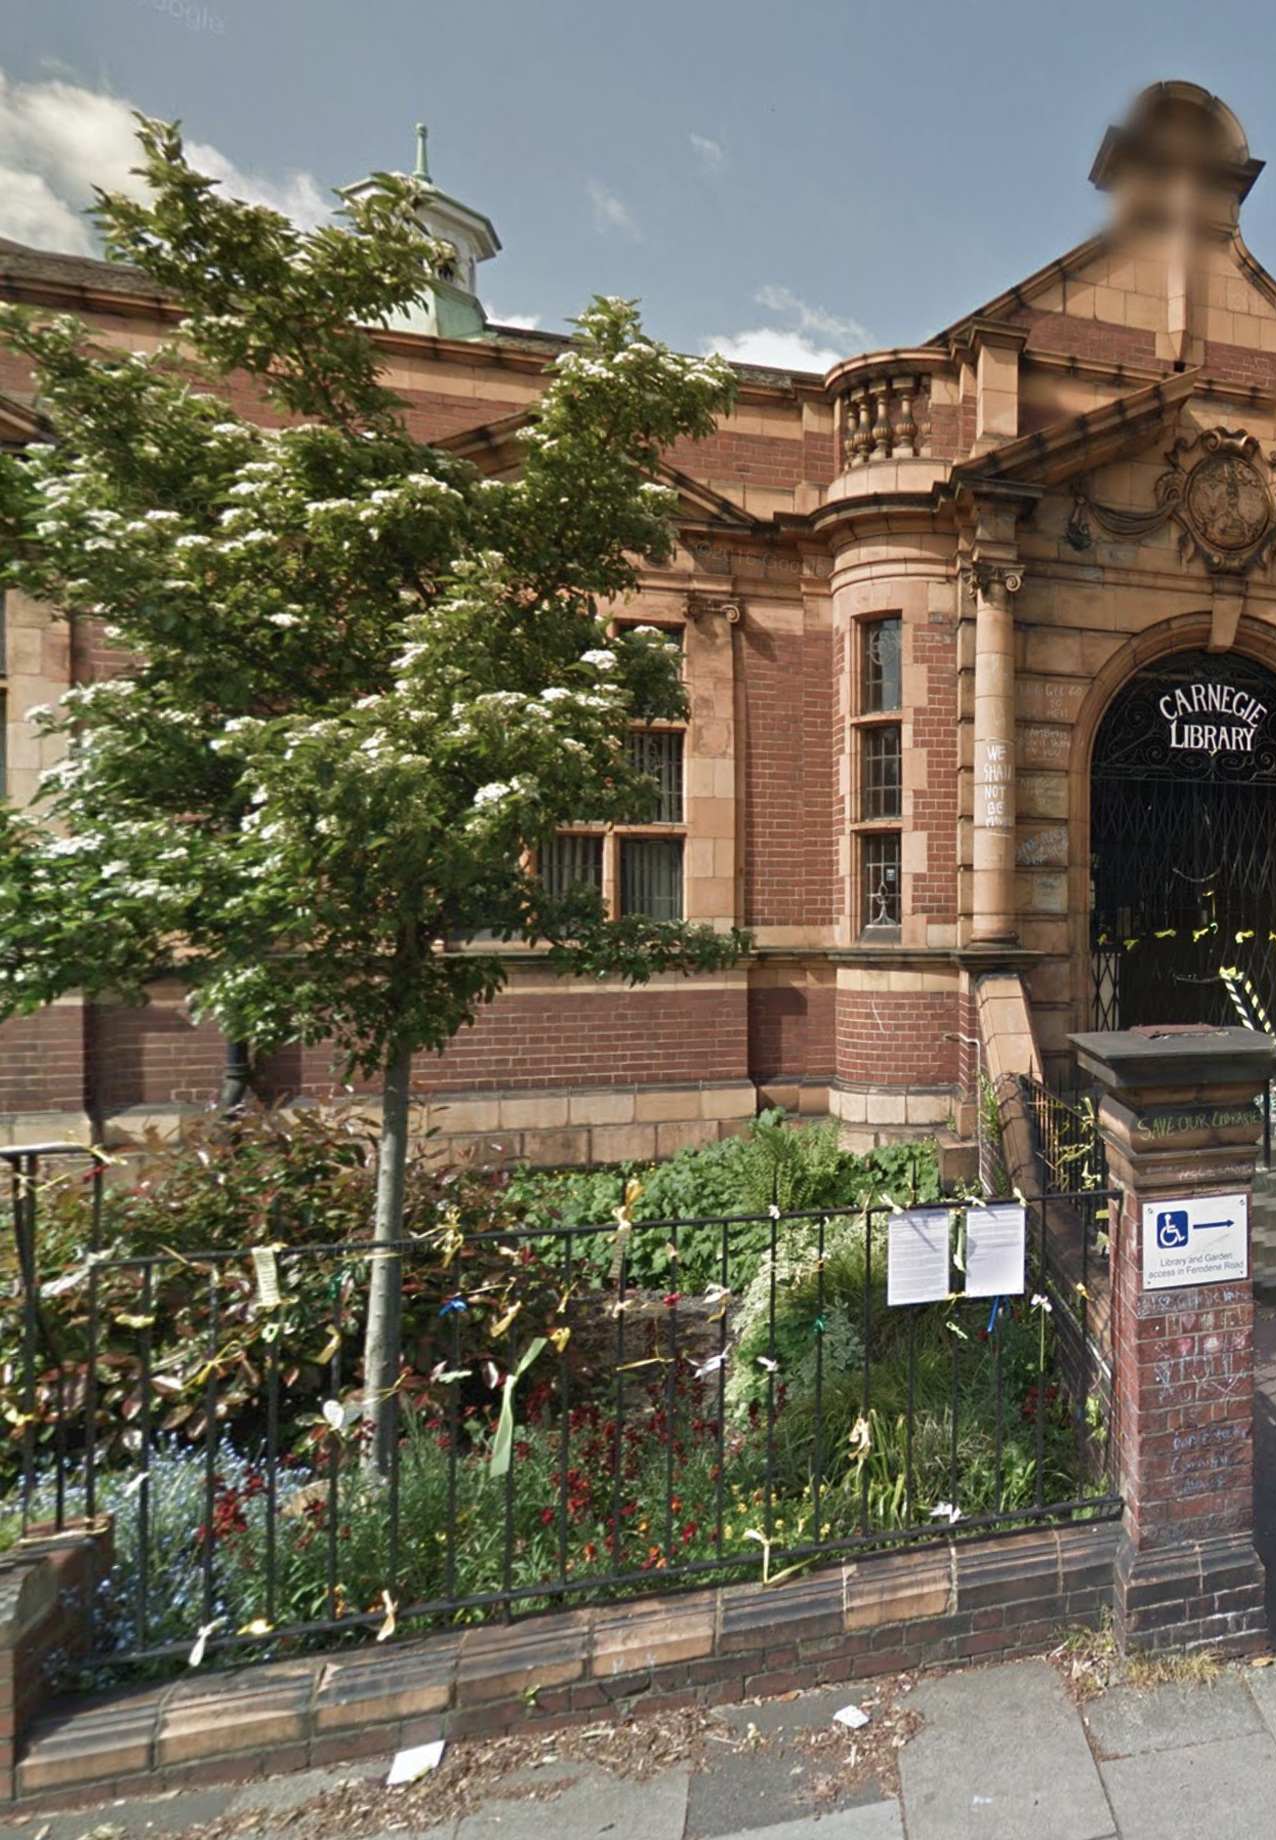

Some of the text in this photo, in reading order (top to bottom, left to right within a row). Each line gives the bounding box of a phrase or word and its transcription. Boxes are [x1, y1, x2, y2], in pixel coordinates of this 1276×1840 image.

[1159, 683, 1267, 728] CARNEGIE
[1169, 720, 1256, 753] LIBRARY
[986, 744, 1006, 761] WE
[984, 785, 1006, 800] NOT
[987, 801, 1005, 815] BE
[1137, 1116, 1175, 1141] SAVE
[1178, 1114, 1210, 1132] OUR
[1160, 1251, 1233, 1268] Library and Garden
[1148, 1269, 1175, 1279] access
[1178, 1266, 1185, 1276] in
[1224, 1260, 1244, 1271] Road
